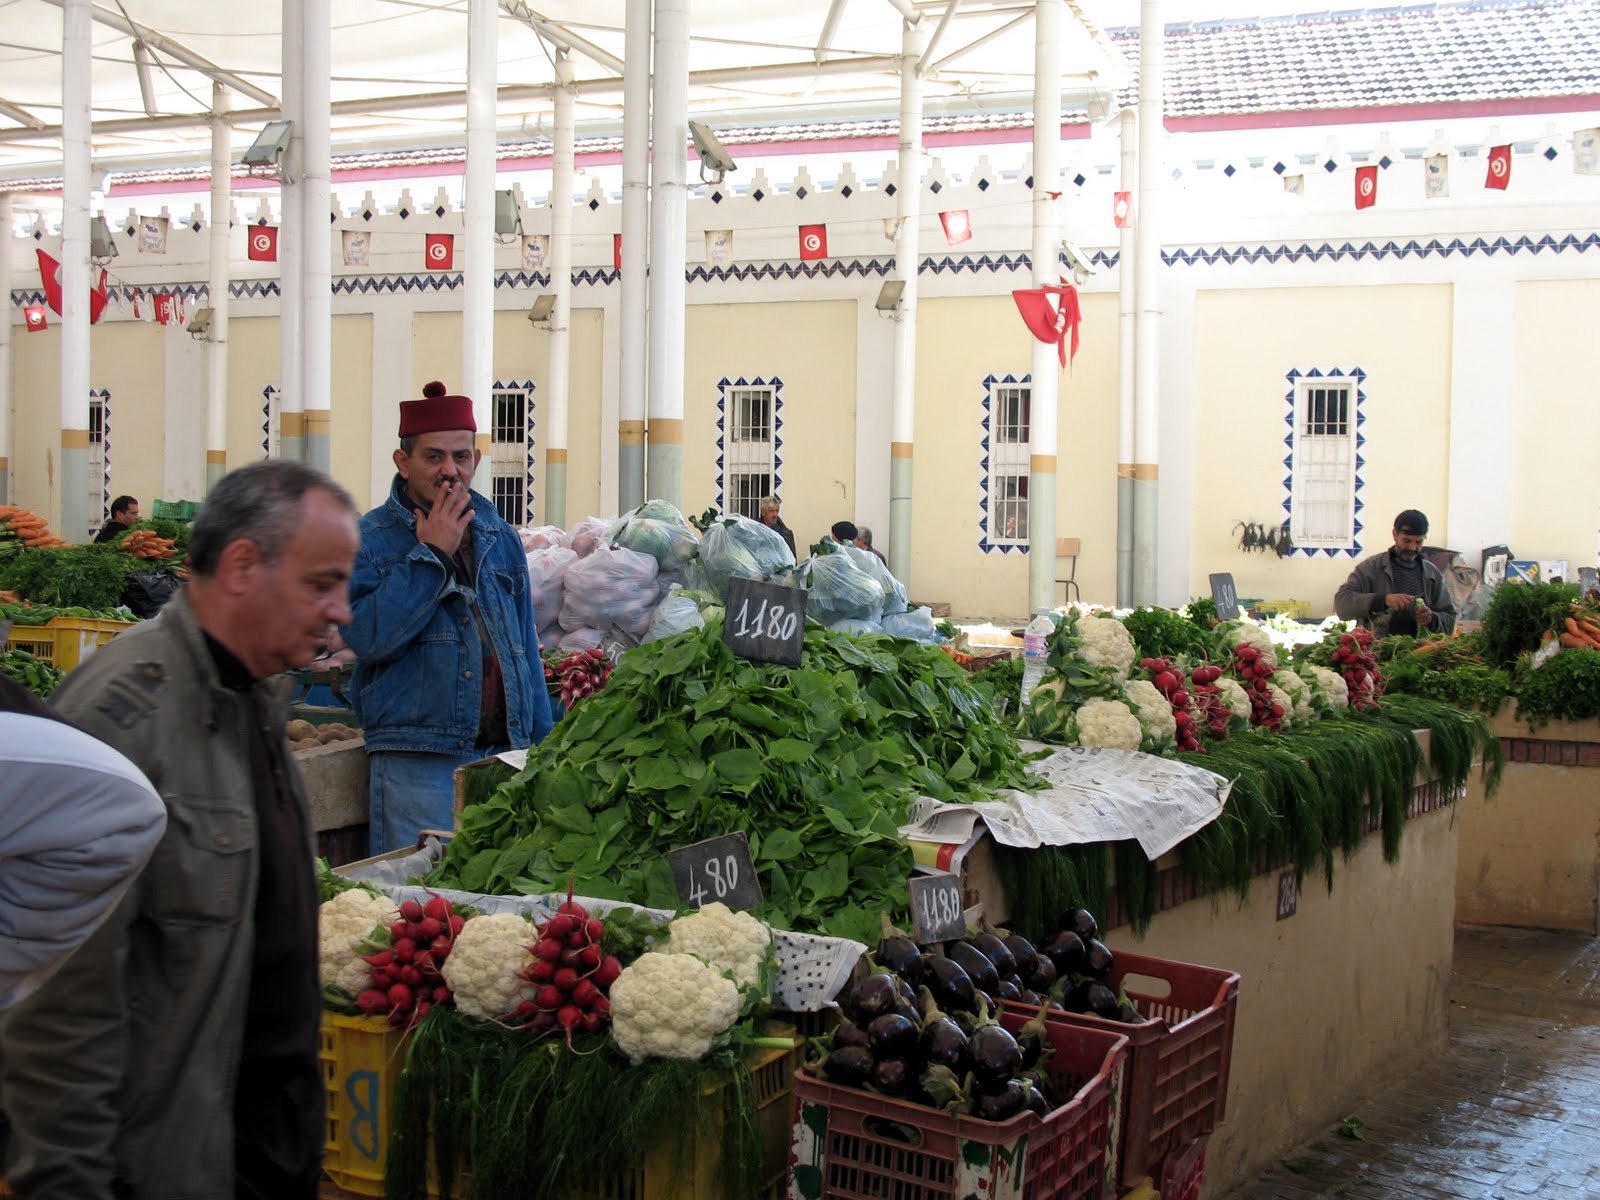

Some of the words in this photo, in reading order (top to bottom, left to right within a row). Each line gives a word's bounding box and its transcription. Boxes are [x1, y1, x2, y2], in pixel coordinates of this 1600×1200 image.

[734, 598, 797, 641] 1180
[689, 854, 739, 907] 480
[923, 887, 960, 930] 1180
